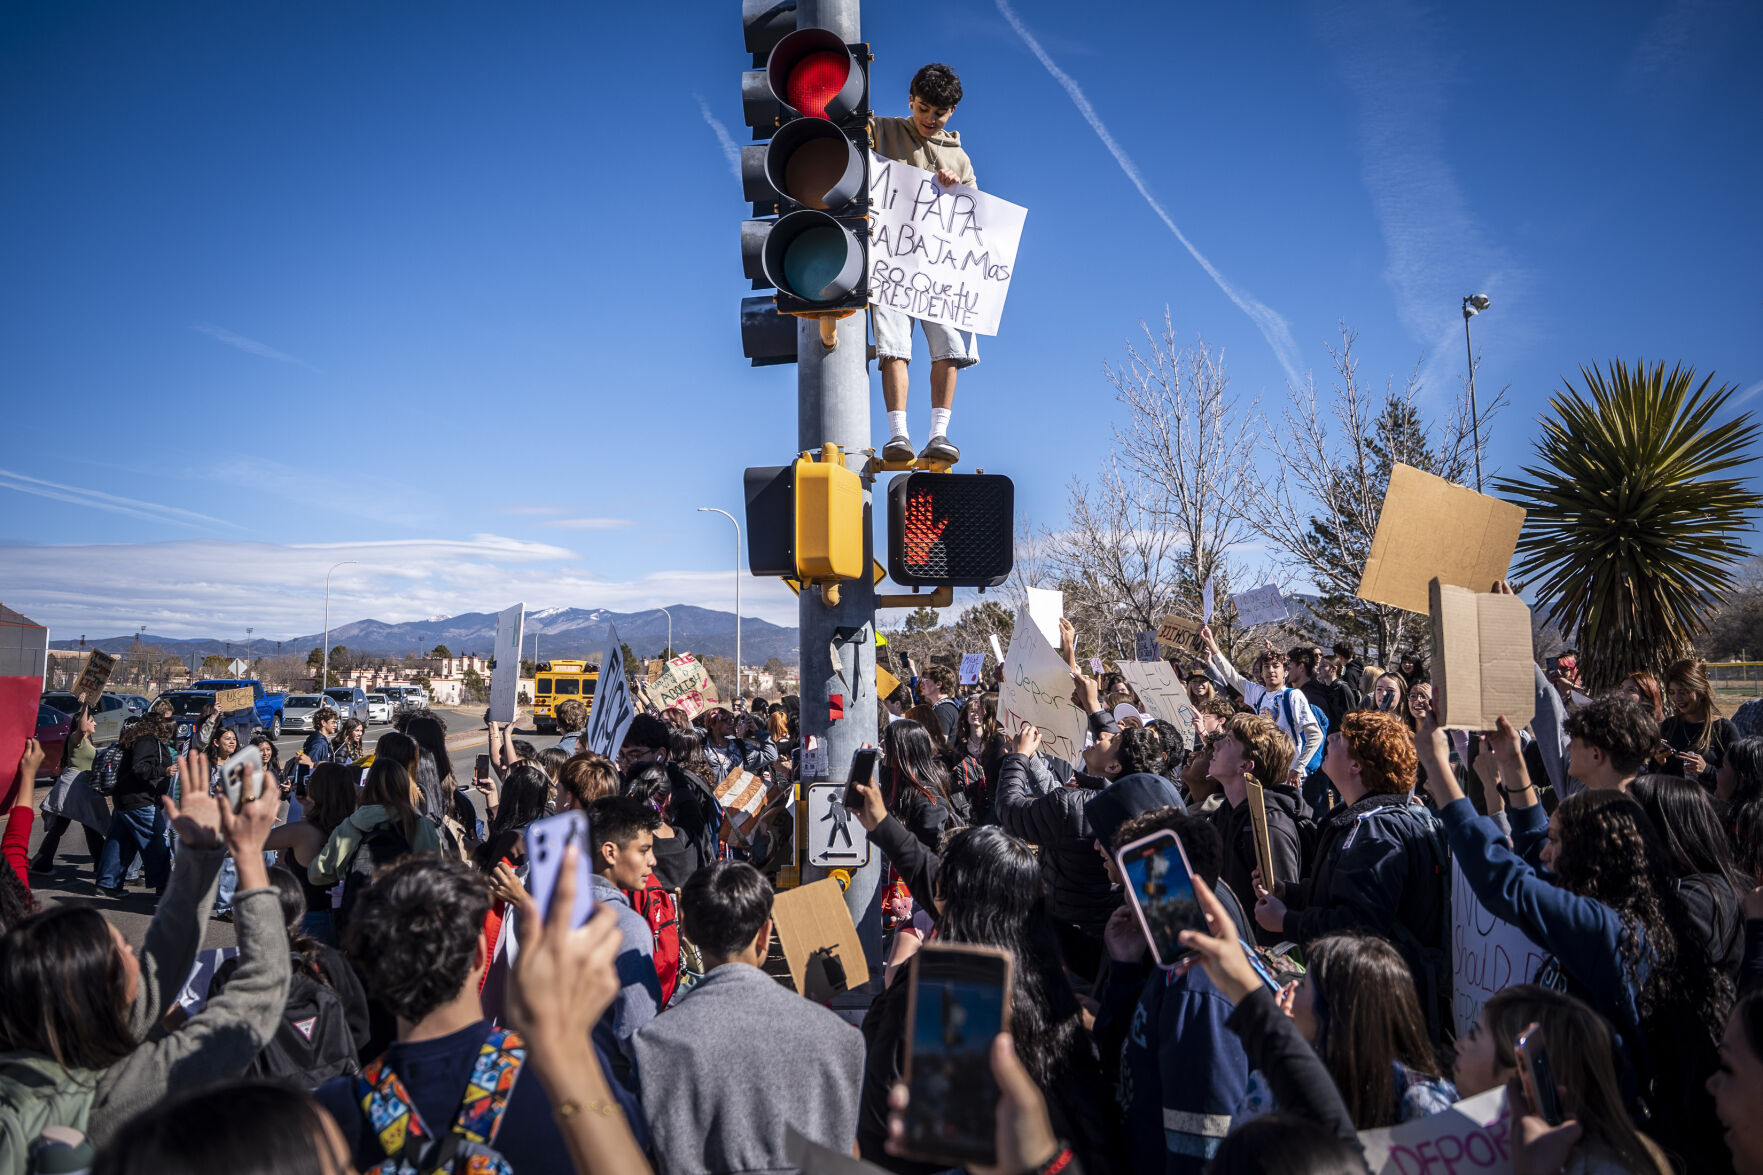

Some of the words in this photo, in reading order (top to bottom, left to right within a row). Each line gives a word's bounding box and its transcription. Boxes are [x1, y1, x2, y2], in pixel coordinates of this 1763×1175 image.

[869, 163, 898, 210] Mi
[911, 179, 983, 247] PAPA
[1388, 1109, 1511, 1175] DEPOR
